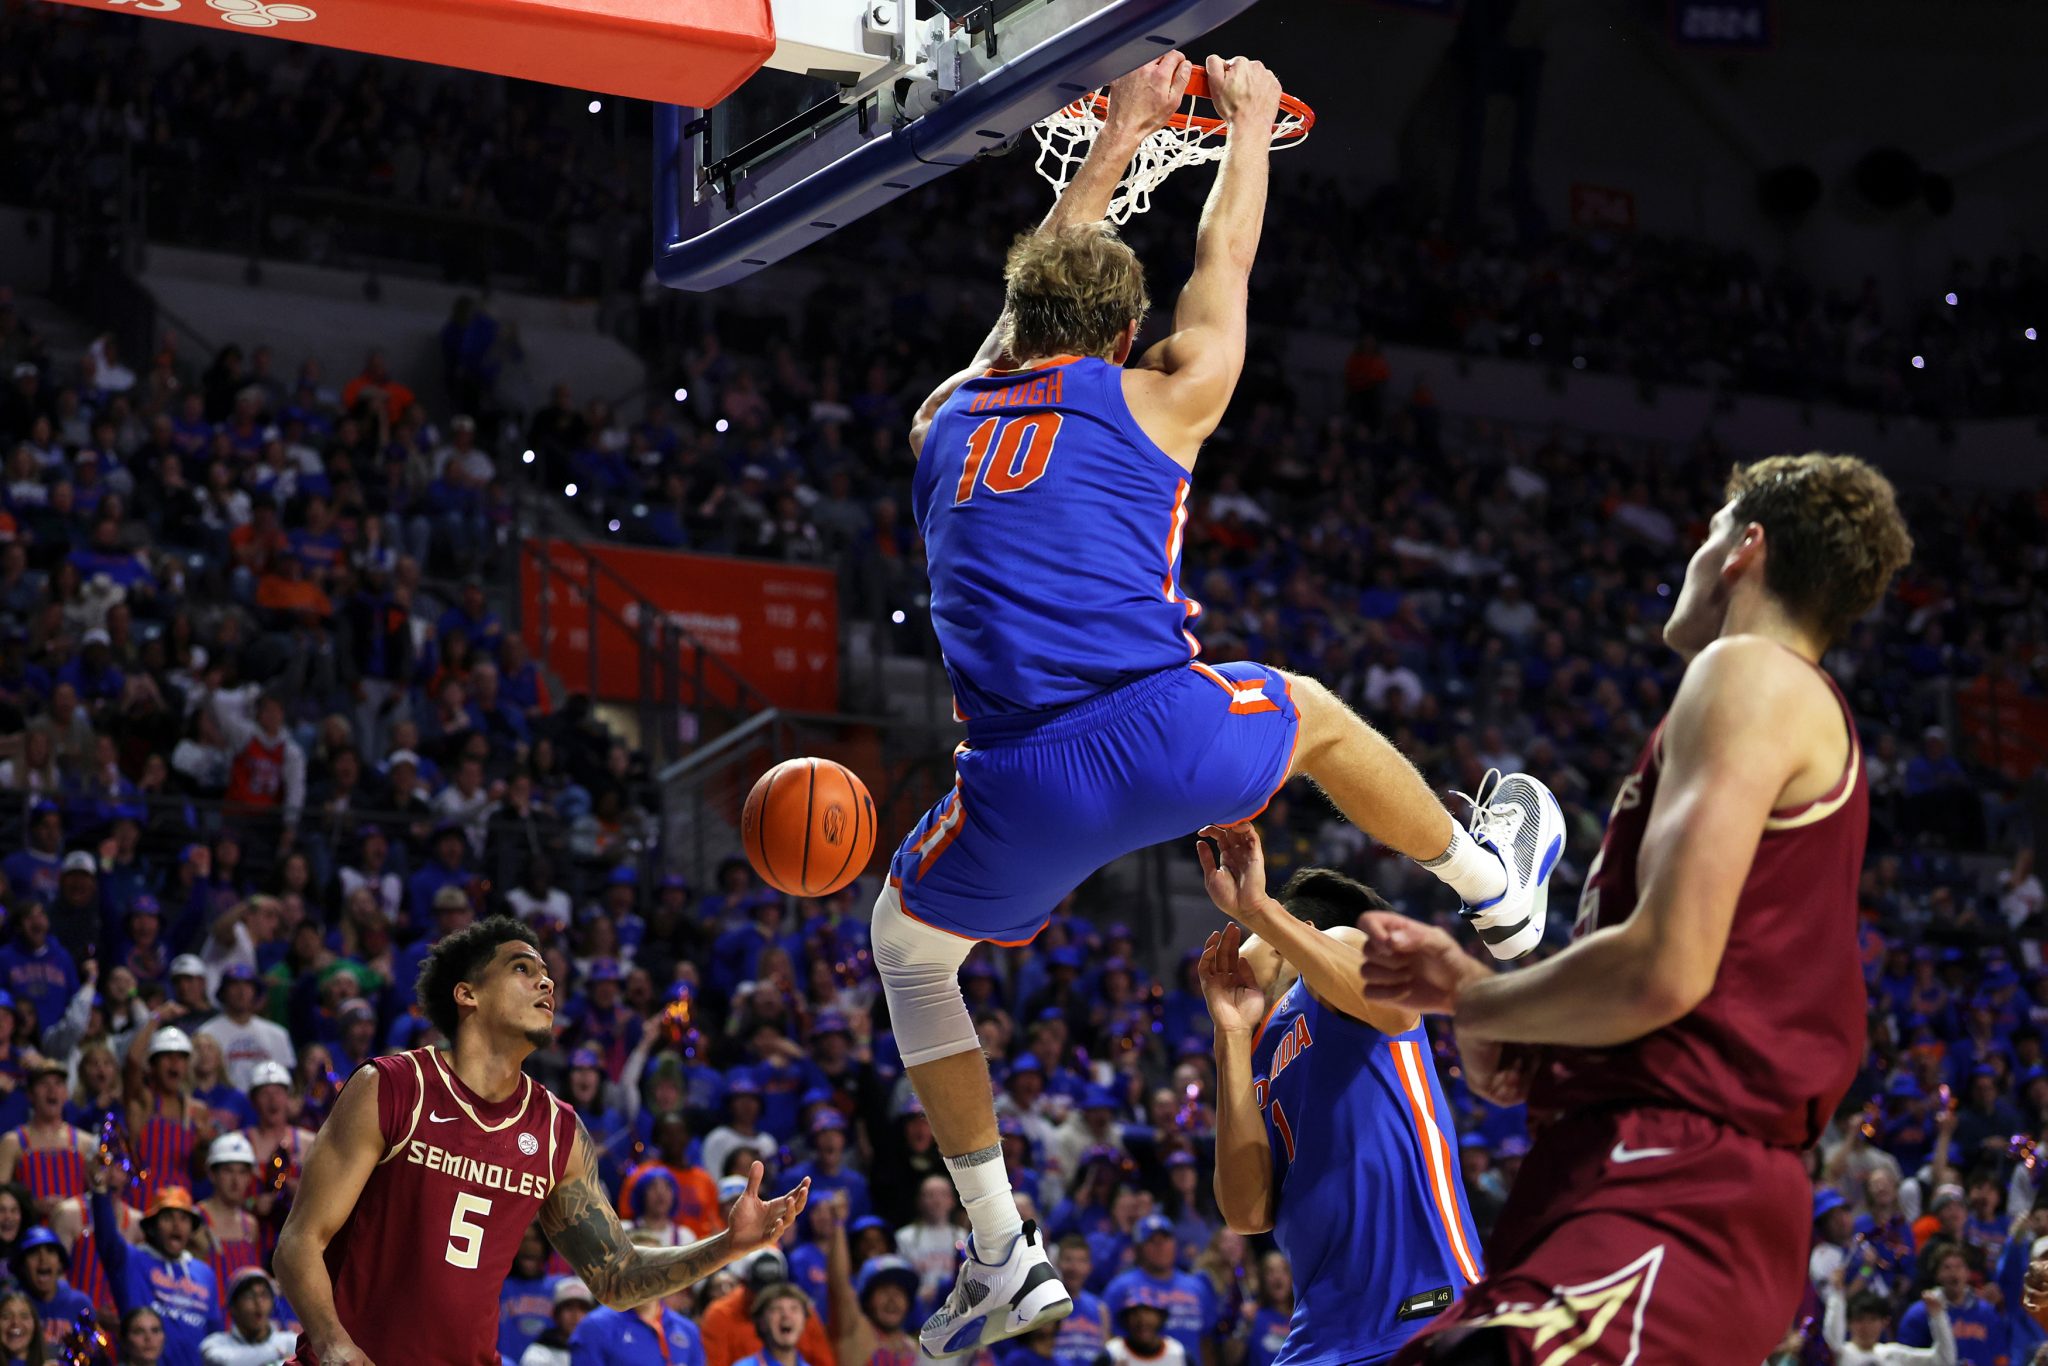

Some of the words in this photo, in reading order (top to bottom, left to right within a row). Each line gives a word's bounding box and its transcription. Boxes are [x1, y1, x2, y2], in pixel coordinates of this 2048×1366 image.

[969, 371, 1064, 413] HAUGH
[955, 410, 1064, 505] 10
[1271, 1098, 1296, 1165] 1
[406, 1139, 548, 1200] SEMINOLES
[445, 1191, 493, 1269] 5
[1437, 1291, 1449, 1302] 46
